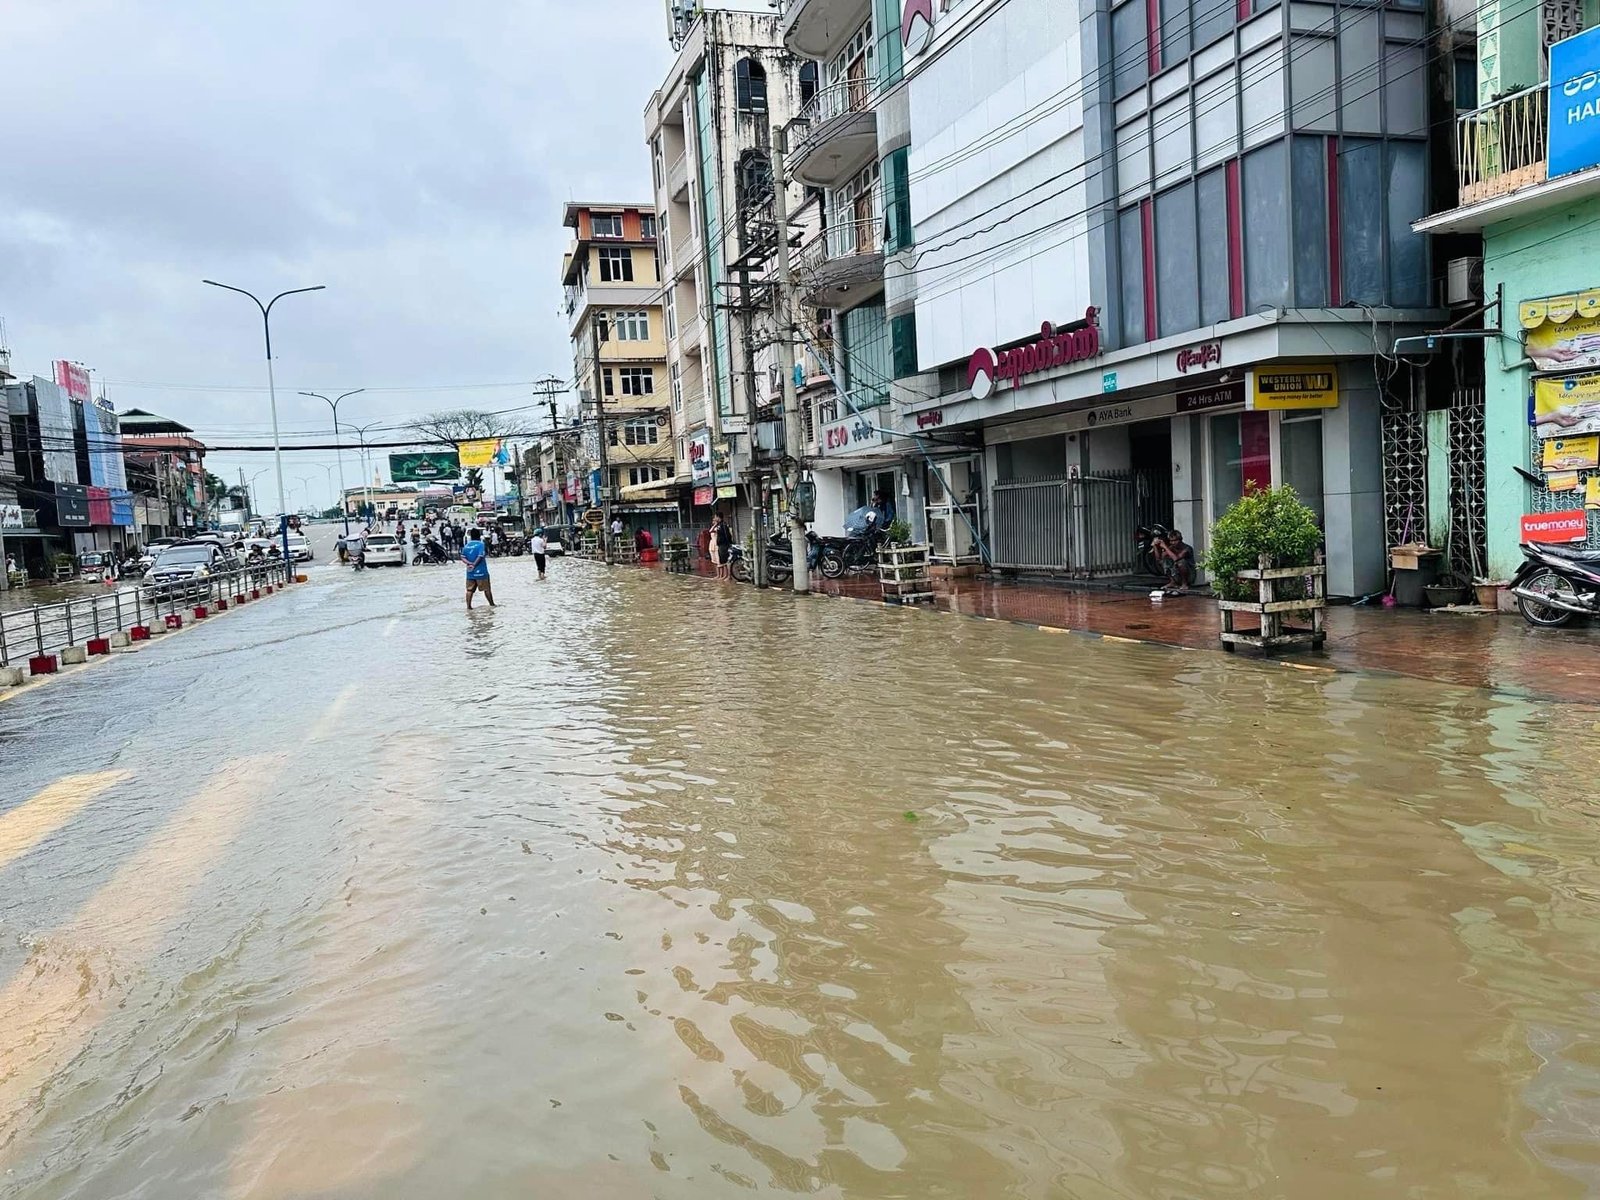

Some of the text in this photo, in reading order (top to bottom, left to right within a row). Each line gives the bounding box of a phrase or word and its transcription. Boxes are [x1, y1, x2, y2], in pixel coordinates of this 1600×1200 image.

[1260, 375, 1301, 384] WESTERN
[1274, 383, 1302, 391] UNION
[1187, 390, 1232, 407] 24 Hrs ATM
[1099, 406, 1132, 421] AYA Bank
